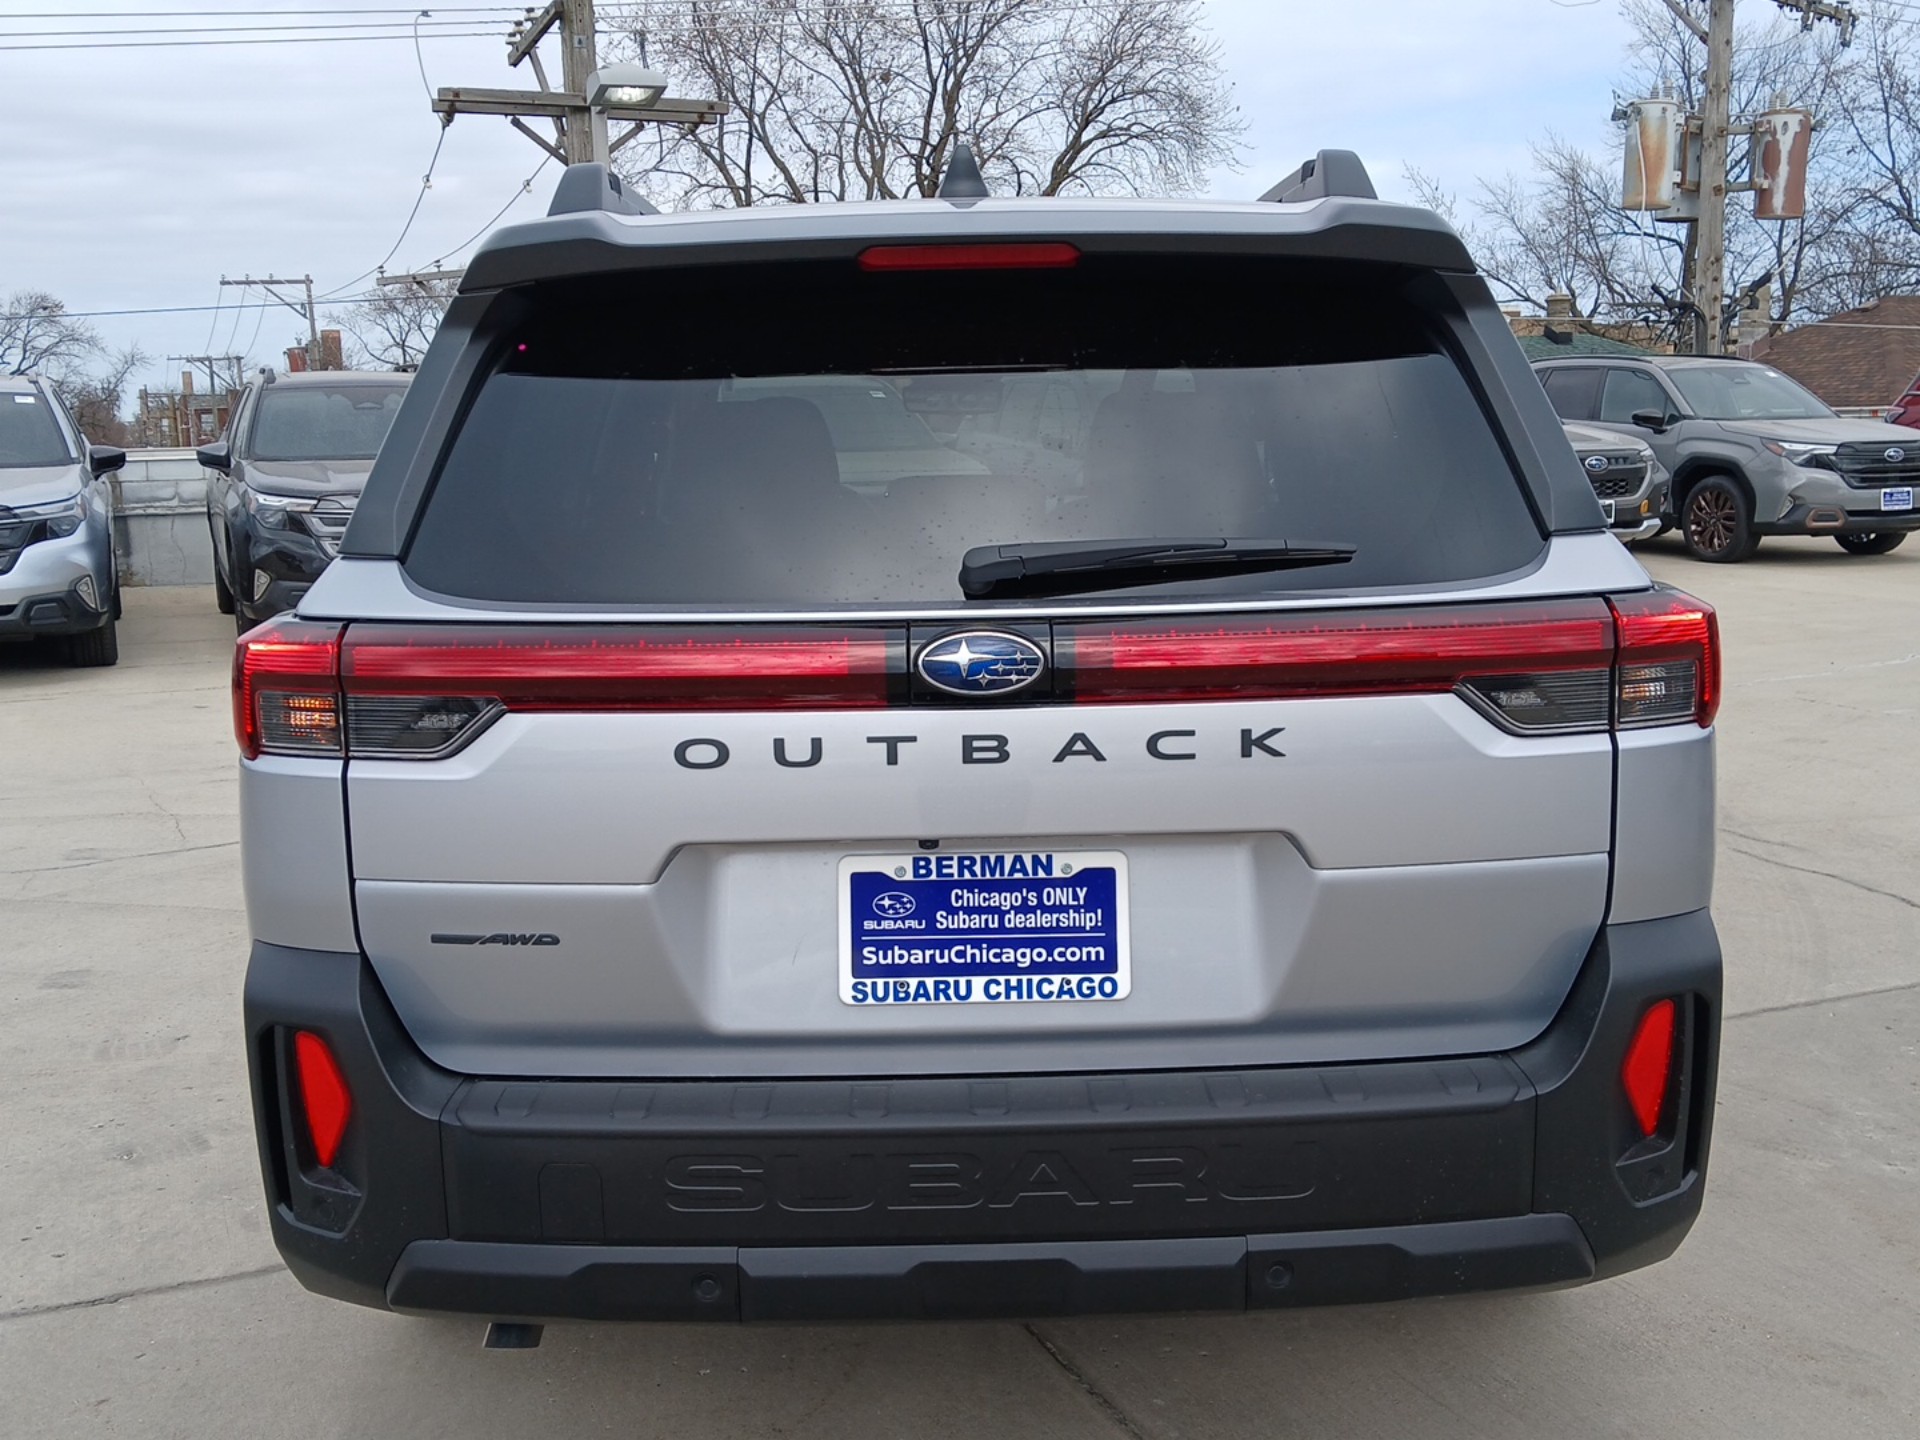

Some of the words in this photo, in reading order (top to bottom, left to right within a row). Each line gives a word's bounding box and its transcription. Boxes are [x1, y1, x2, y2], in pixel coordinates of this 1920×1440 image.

[674, 727, 1287, 770] OUTBACK
[912, 854, 1053, 879] BERMAN
[951, 889, 1037, 909] Chicago's
[1042, 887, 1087, 906] ONLY
[863, 919, 925, 930] SUBARU
[935, 910, 998, 929] Subaru
[1004, 908, 1102, 931] dealership!
[478, 933, 561, 946] AWD
[862, 944, 1105, 967] SubaruChicago.com
[851, 979, 972, 1003] SUBARU
[983, 976, 1118, 1000] CHICAGO
[665, 1141, 1317, 1212] SUBARU
